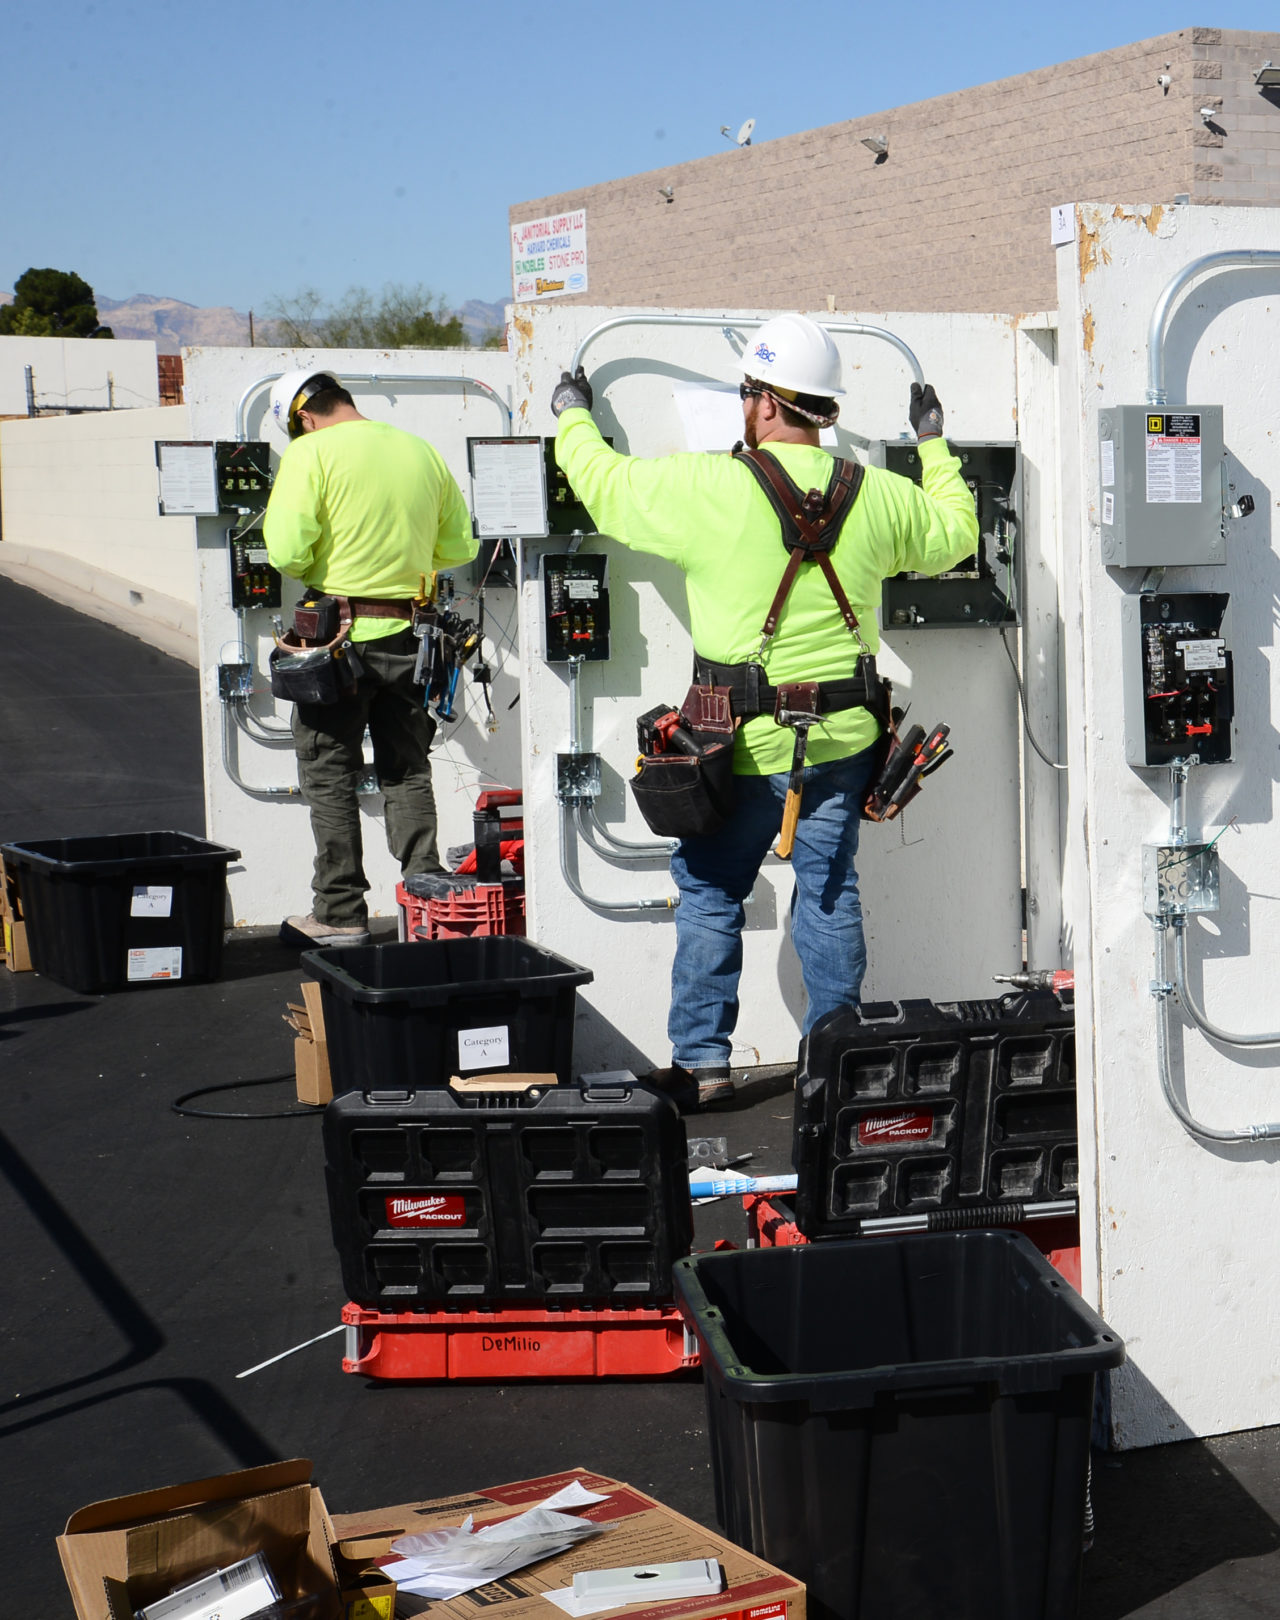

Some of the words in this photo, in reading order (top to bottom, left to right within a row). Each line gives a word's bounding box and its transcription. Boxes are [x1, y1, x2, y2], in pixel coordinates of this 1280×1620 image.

[552, 215, 572, 234] SUPPLY
[754, 348, 776, 363] ABC
[136, 892, 167, 902] Category
[463, 1036, 503, 1047] Category
[865, 1111, 918, 1133] Milwaukee
[888, 1127, 930, 1136] PACKOUT
[389, 1196, 447, 1215] Milwaukee
[482, 1336, 541, 1351] DeMilio
